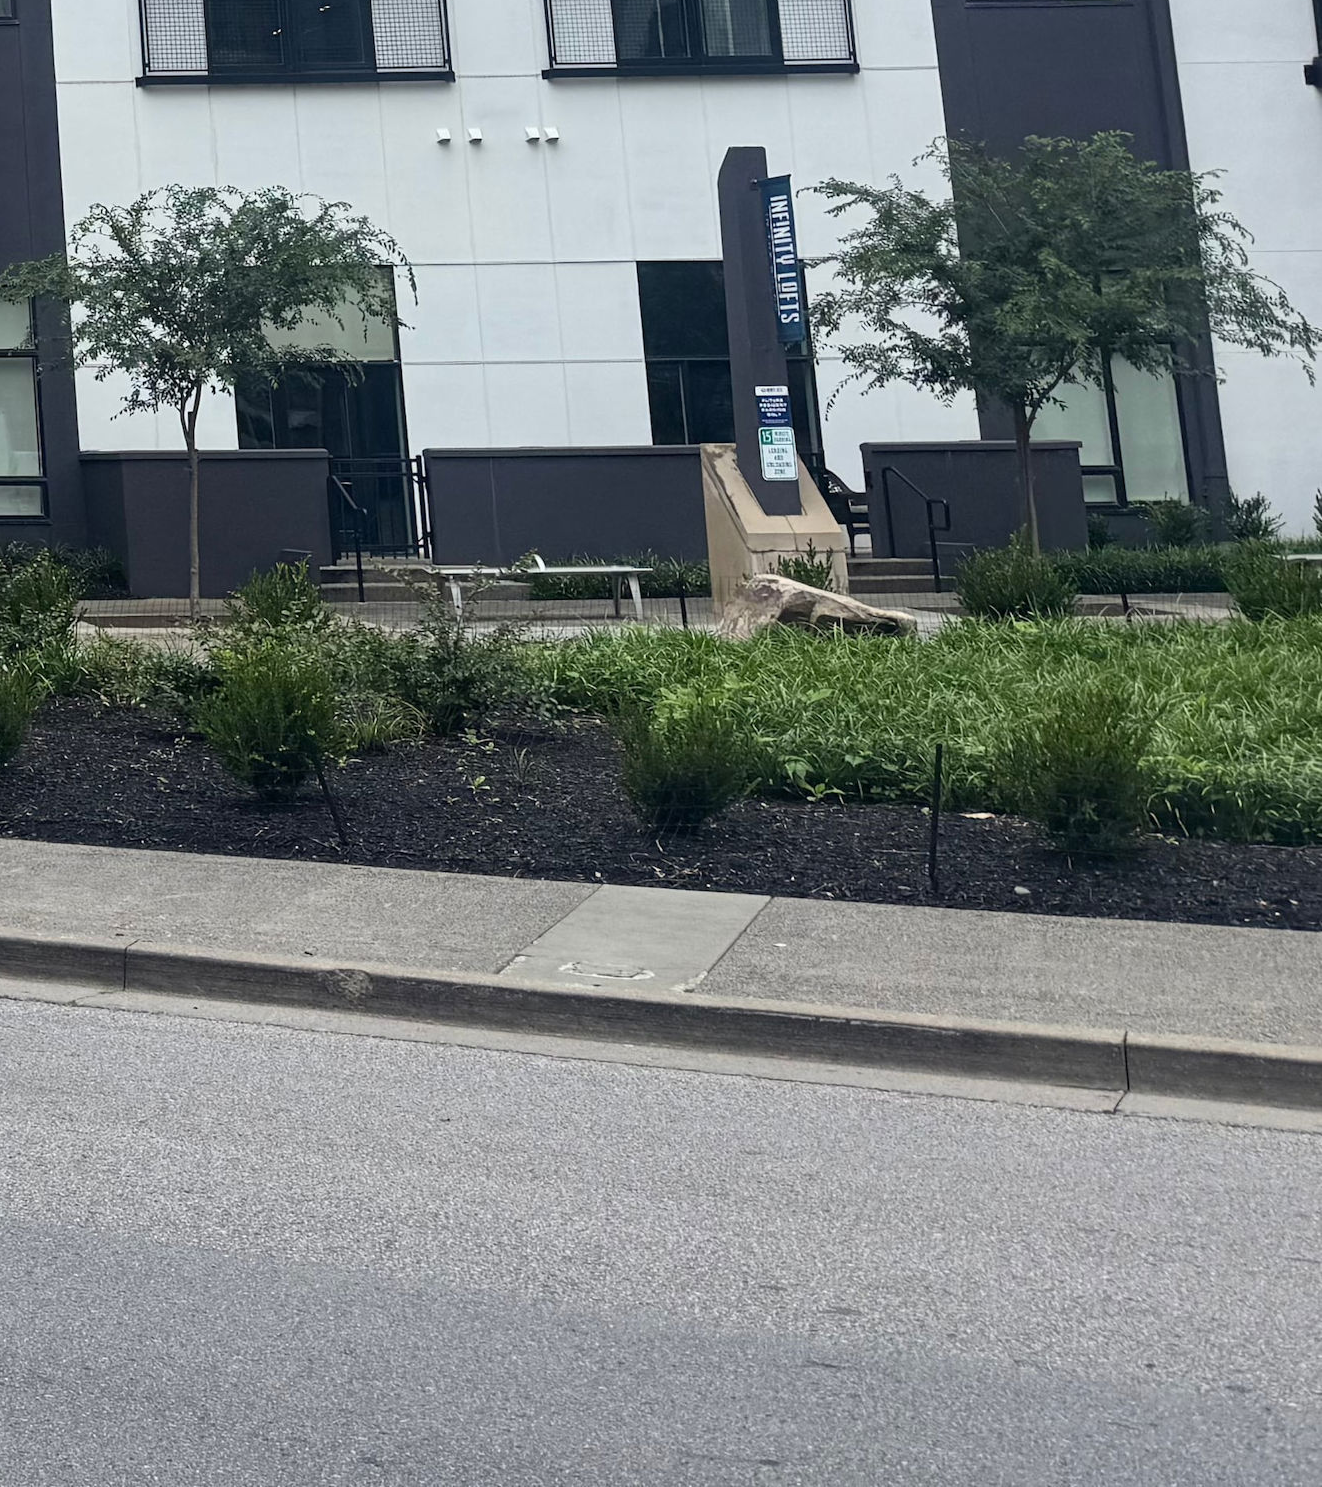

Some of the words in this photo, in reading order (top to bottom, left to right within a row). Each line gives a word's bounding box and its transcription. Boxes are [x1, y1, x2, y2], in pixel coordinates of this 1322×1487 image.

[769, 194, 796, 266] INFINITY
[776, 271, 800, 324] LOFTS
[761, 430, 772, 443] 15
